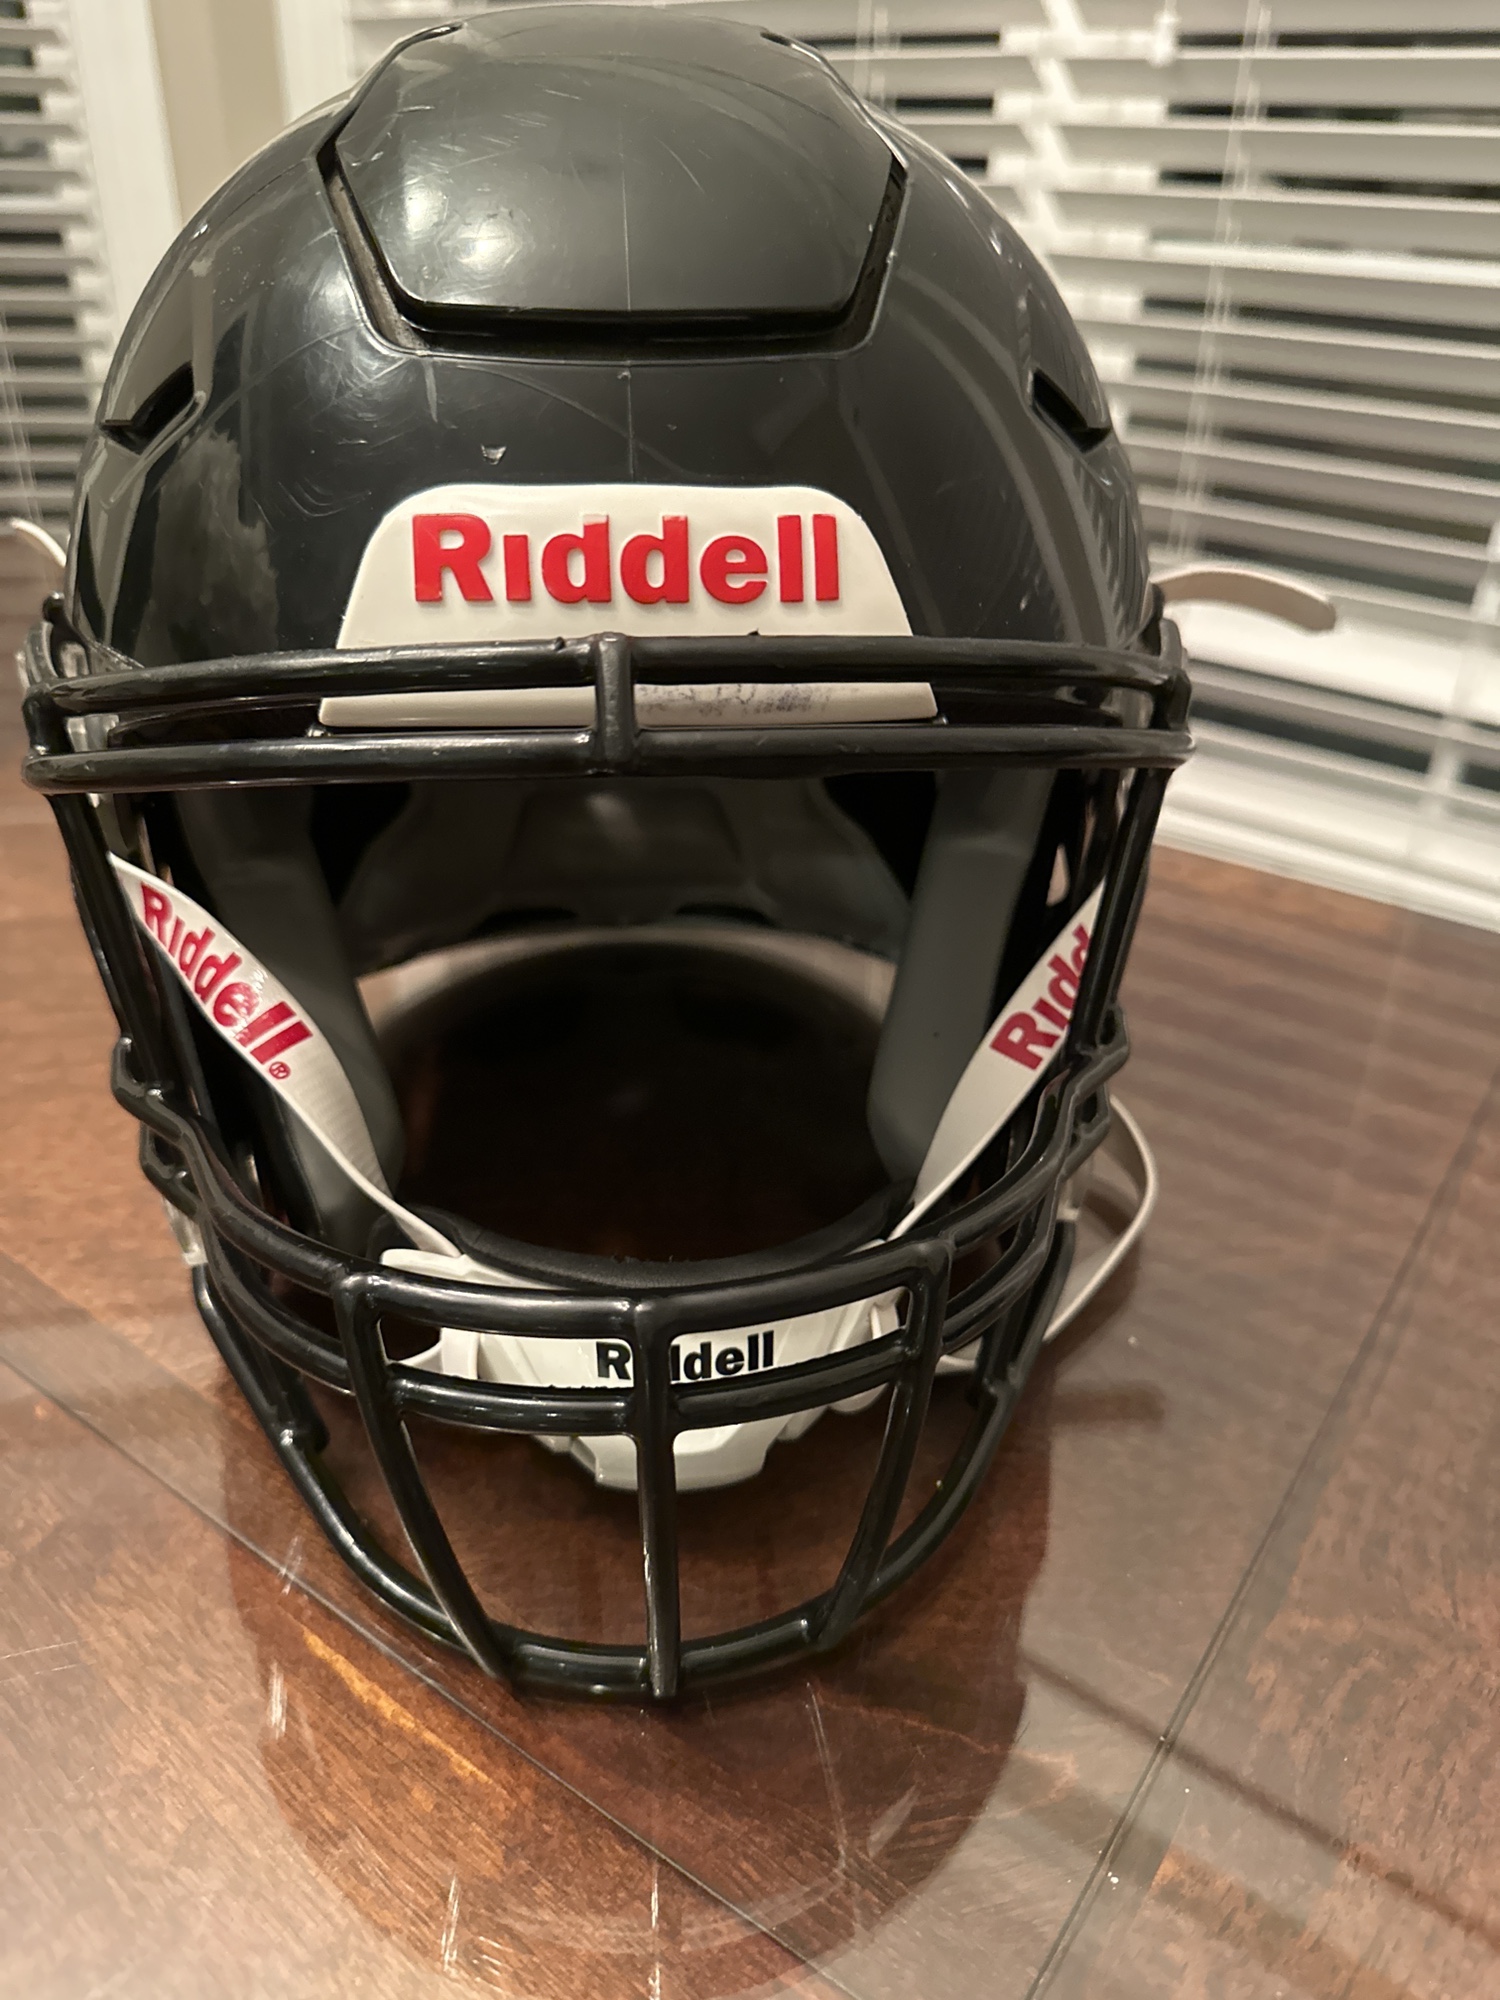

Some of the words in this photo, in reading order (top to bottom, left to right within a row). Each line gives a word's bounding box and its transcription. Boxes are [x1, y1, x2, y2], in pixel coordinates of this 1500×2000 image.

[412, 512, 839, 604] Riddell
[989, 923, 1090, 1071] Ridd
[596, 1329, 774, 1381] Rdell
